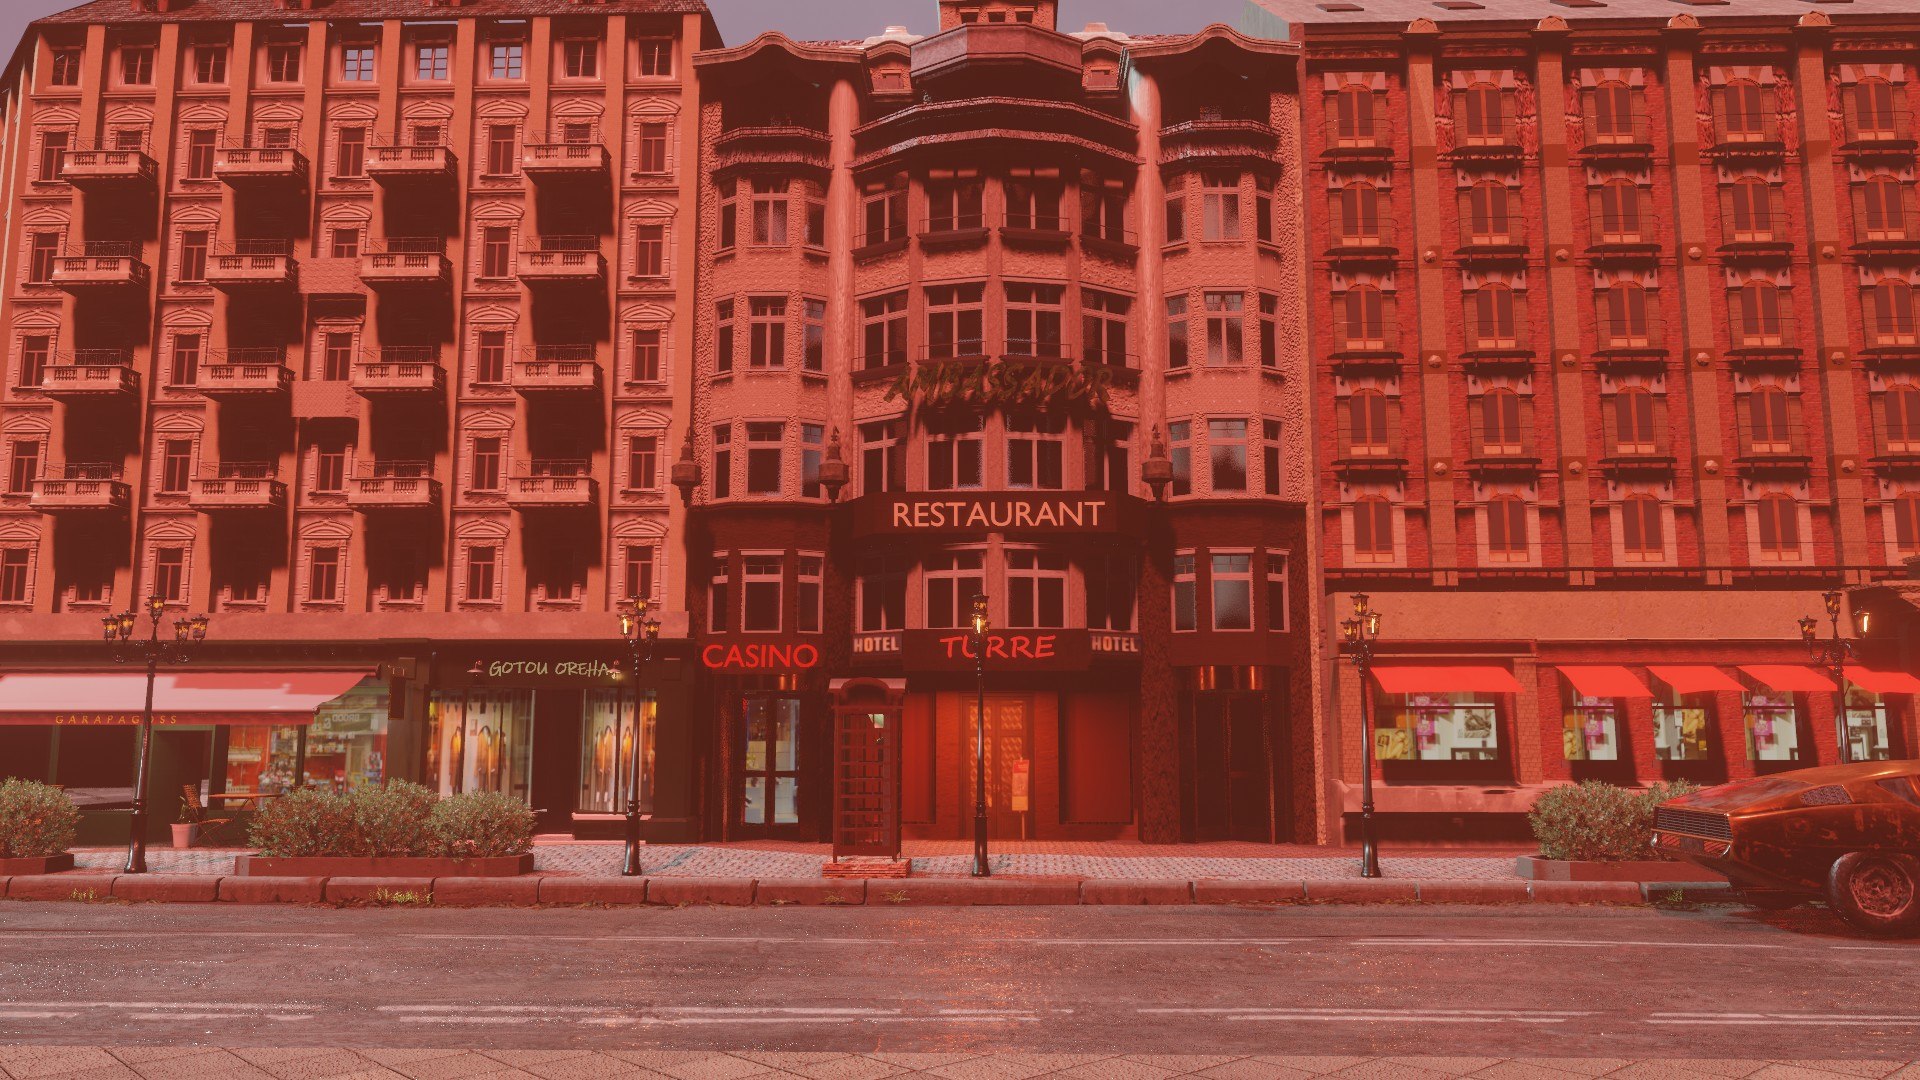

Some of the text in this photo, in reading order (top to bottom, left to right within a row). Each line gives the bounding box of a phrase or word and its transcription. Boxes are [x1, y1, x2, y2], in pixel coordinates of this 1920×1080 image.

[883, 361, 1113, 402] AMBASSADOR
[893, 501, 1106, 527] RESTAURANT
[853, 636, 899, 653] HOTEL
[1091, 636, 1139, 652] HOTEL
[702, 643, 819, 668] CASINO
[489, 660, 548, 677] GOTOU
[55, 715, 177, 725] GARAPAGSS
